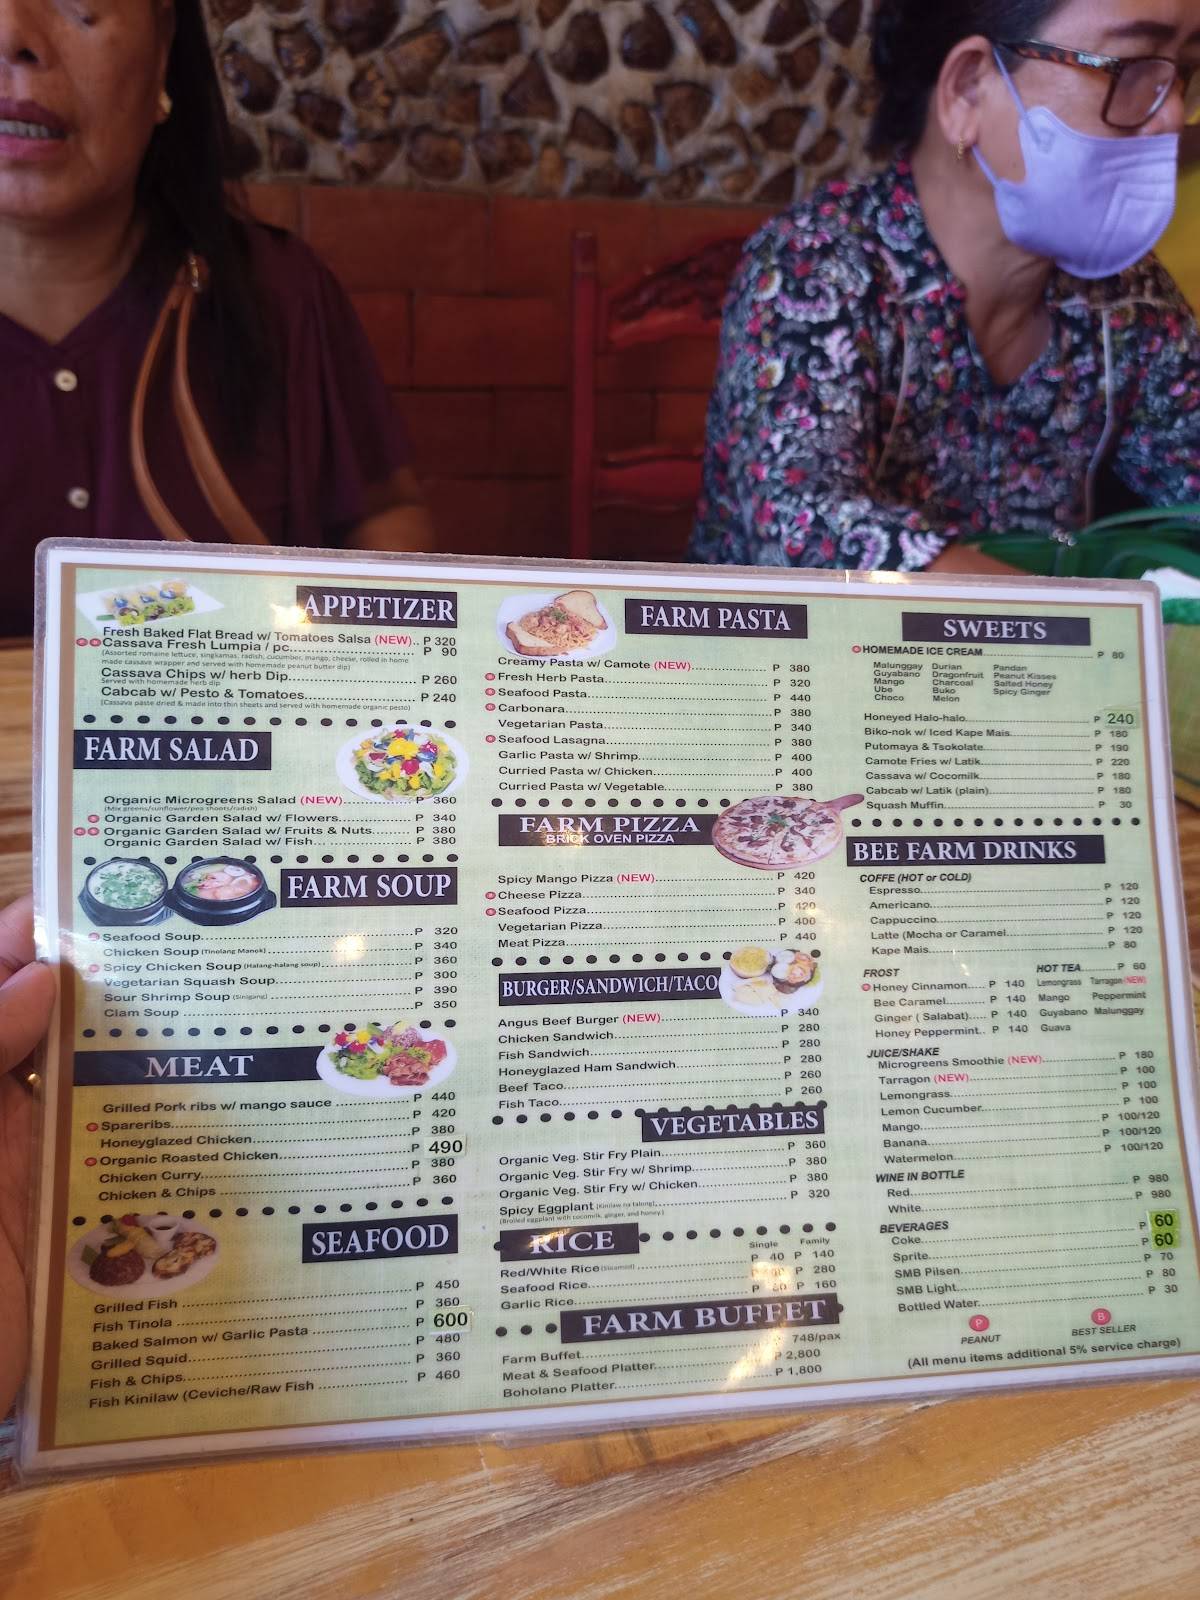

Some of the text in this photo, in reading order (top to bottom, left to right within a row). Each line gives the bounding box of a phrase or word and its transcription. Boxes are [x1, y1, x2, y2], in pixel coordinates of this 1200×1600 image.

[302, 594, 455, 623] APPETIZER
[641, 606, 791, 630] FARM PASTA
[103, 626, 140, 637] Fresh
[143, 628, 184, 638] Baked
[188, 629, 212, 639] Flat
[215, 630, 253, 640] Bread
[257, 632, 271, 641] w/
[274, 631, 334, 643] Tomatoes
[338, 633, 371, 644] Salsa
[423, 636, 431, 645] P
[435, 637, 456, 646] 320
[944, 619, 1047, 639] SWEETS
[863, 645, 924, 655] HOMEMADE
[926, 647, 943, 655] ICE
[498, 657, 546, 668] Creamy
[550, 658, 583, 667] Pasta
[587, 659, 601, 667] w/
[604, 660, 650, 669] Camote
[773, 664, 780, 672] P
[789, 664, 810, 672] 380
[873, 661, 923, 671] Malunggay
[873, 669, 920, 678] Guyabano
[932, 671, 984, 680] Dragonfruit
[864, 713, 912, 723] Honeyed
[1107, 713, 1134, 725] 240
[84, 737, 258, 761] FARM SALAD
[104, 814, 161, 824] Organic
[166, 814, 218, 822] Garden
[223, 814, 262, 822] Salad
[266, 814, 282, 822] w/
[433, 814, 456, 822] 340
[520, 816, 700, 834] FARM PIZZA
[546, 834, 674, 844] BRICK OVEN PIZZA
[853, 841, 1076, 861] BEE FARM DRINKS
[288, 874, 451, 898] FARM SOUP
[498, 875, 532, 885] Spicy
[536, 875, 577, 885] Mango
[581, 874, 613, 882] Pizza
[777, 872, 785, 880] P
[794, 871, 815, 880] 420
[860, 874, 895, 883] COFFE
[897, 873, 924, 884] (HOT
[939, 873, 972, 883] COLD)
[104, 963, 142, 974] Spicy
[146, 963, 202, 971] Chicken
[206, 962, 242, 972] Soup
[415, 957, 423, 965] P
[434, 956, 457, 964] 360
[863, 968, 900, 978] FROST
[1036, 964, 1059, 973] HOT
[1133, 962, 1146, 970] 60
[502, 974, 718, 998] BURGER/SANDWICH/TACO
[867, 1047, 940, 1058] JUICE/SHAKE
[146, 1055, 254, 1077] MEAT
[102, 1103, 151, 1114] Grilled
[154, 1102, 186, 1112] Pork
[190, 1102, 217, 1111] ribs
[220, 1101, 236, 1110] w/
[240, 1102, 286, 1111] mango
[414, 1093, 422, 1102] P
[431, 1092, 456, 1101] 440
[650, 1111, 818, 1136] VEGETABLES
[99, 1154, 157, 1167] Organic
[161, 1152, 219, 1163] Roasted
[411, 1143, 420, 1152] P
[429, 1140, 463, 1154] 490
[1104, 1144, 1111, 1152] P
[1121, 1141, 1164, 1151] 100/120
[499, 1171, 549, 1183] Organic
[552, 1170, 579, 1180] Veg.
[583, 1168, 605, 1177] Stir
[609, 1166, 628, 1177] Fry
[631, 1165, 645, 1175] w/
[788, 1158, 796, 1167] P
[806, 1156, 827, 1165] 380
[876, 1169, 965, 1183] WINE IN BOTTLE
[880, 1220, 949, 1234] BEVERAGES
[1139, 1221, 1146, 1230] P
[1154, 1213, 1174, 1227] 60
[312, 1224, 449, 1256] SEAFOOD
[529, 1230, 615, 1255] RICE
[749, 1237, 830, 1249] Single Family
[500, 1267, 567, 1278] Red/White
[751, 1254, 758, 1262] P
[770, 1252, 784, 1261] 40
[794, 1251, 802, 1260] P
[813, 1249, 834, 1258] 140
[583, 1299, 827, 1335] FARM BUFFET
[92, 1338, 139, 1352] Baked
[143, 1336, 197, 1347] Salmon
[201, 1332, 218, 1343] w/
[222, 1329, 265, 1341] Garlic
[416, 1317, 424, 1327] P
[433, 1312, 468, 1328] 600
[961, 1334, 1001, 1344] PEANUT
[1072, 1324, 1136, 1336] BEST SELLER
[908, 1337, 1181, 1369] (All menu items additional 5% service charge)
[503, 1371, 535, 1381] Meat
[539, 1369, 549, 1378] &
[553, 1365, 607, 1377] Seafood
